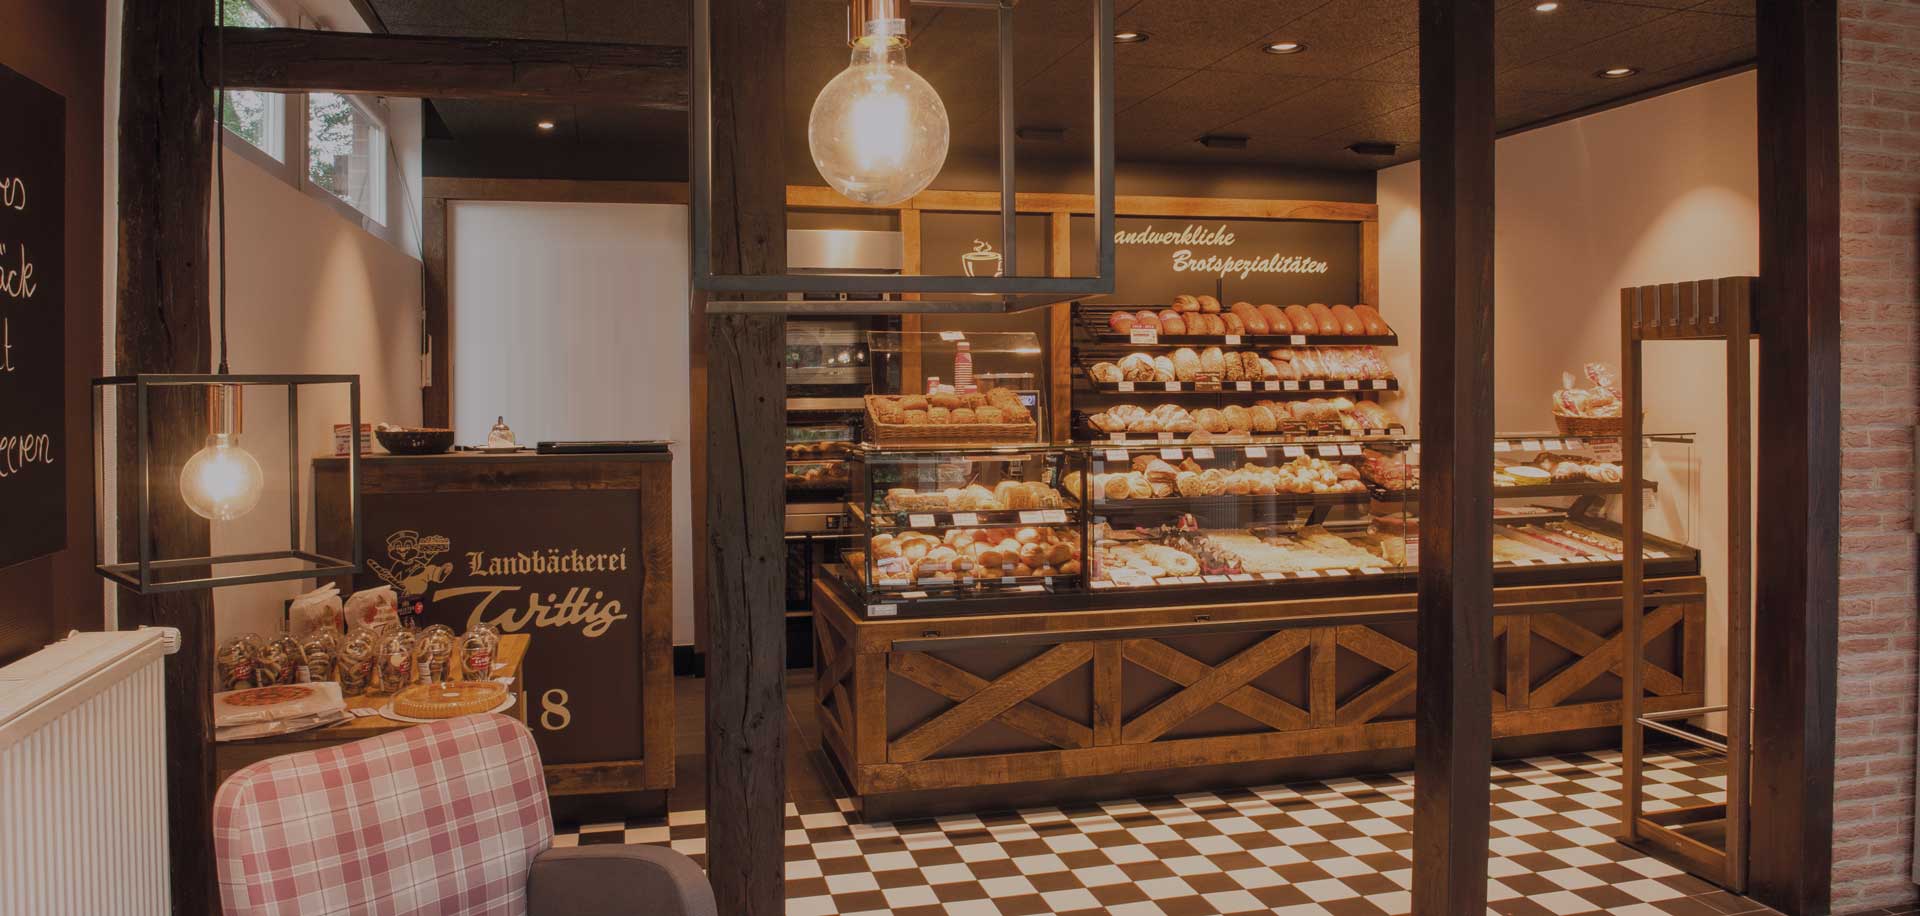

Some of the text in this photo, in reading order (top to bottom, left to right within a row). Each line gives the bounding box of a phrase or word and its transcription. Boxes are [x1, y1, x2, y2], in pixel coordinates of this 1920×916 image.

[1114, 224, 1235, 246] andwerkliche
[0, 242, 37, 299] äck
[1172, 250, 1328, 280] Brotspezialitäten
[468, 549, 627, 576] Landbäckerei
[433, 586, 628, 638] Wittig
